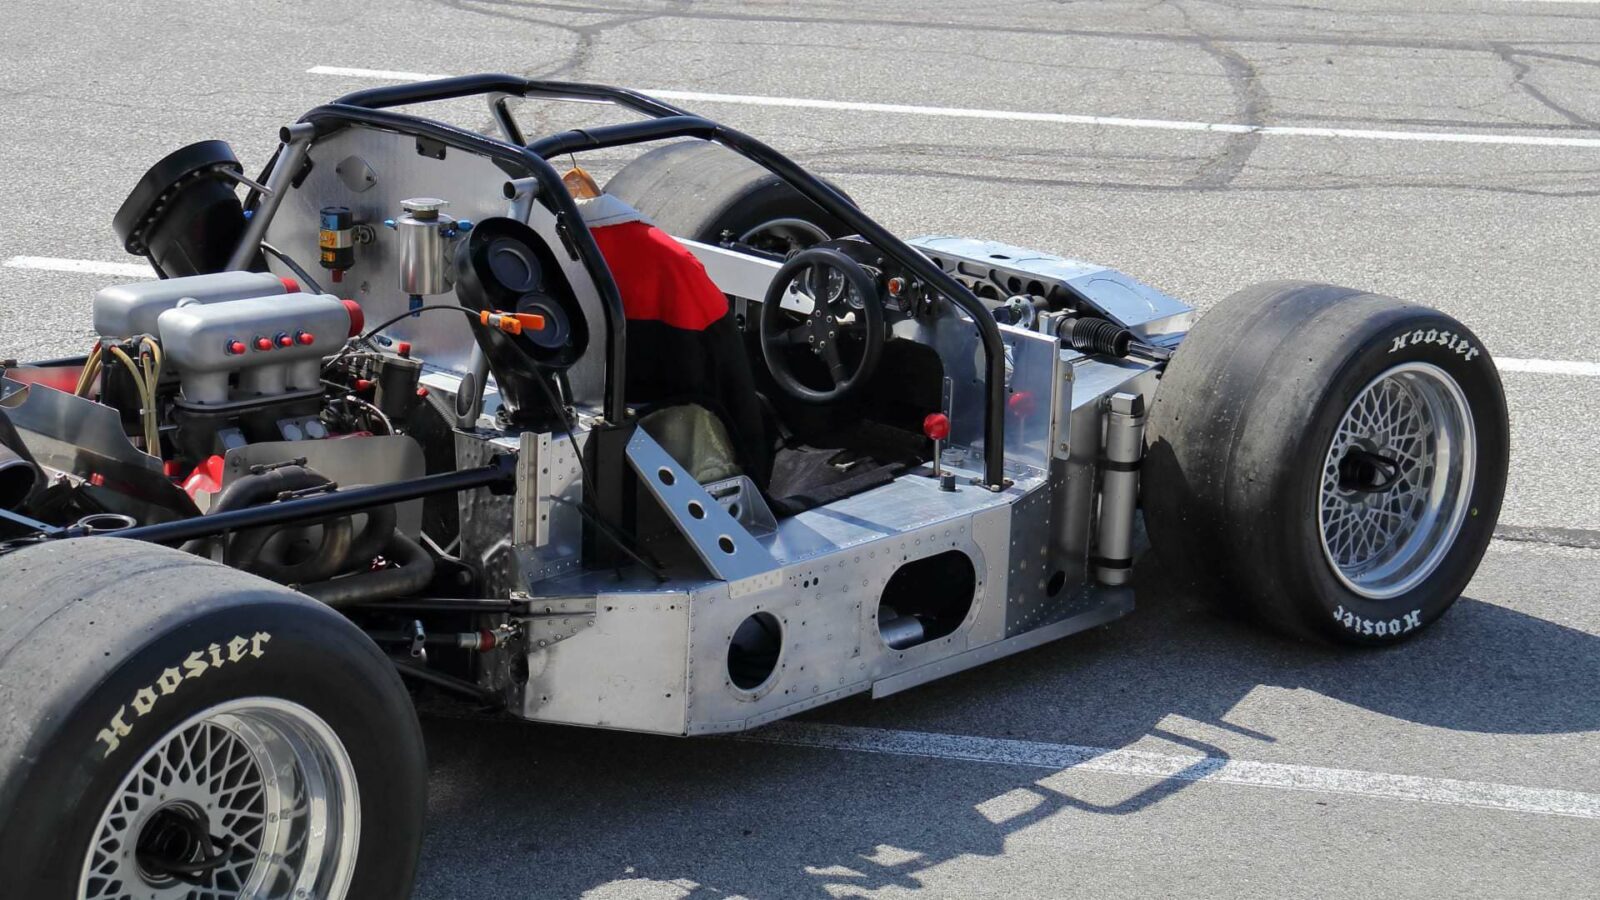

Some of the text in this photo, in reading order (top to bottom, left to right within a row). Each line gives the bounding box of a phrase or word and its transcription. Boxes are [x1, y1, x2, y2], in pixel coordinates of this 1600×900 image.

[1388, 328, 1479, 361] Hoosier
[1333, 605, 1421, 637] Hoosier
[96, 631, 271, 758] Hoosier
